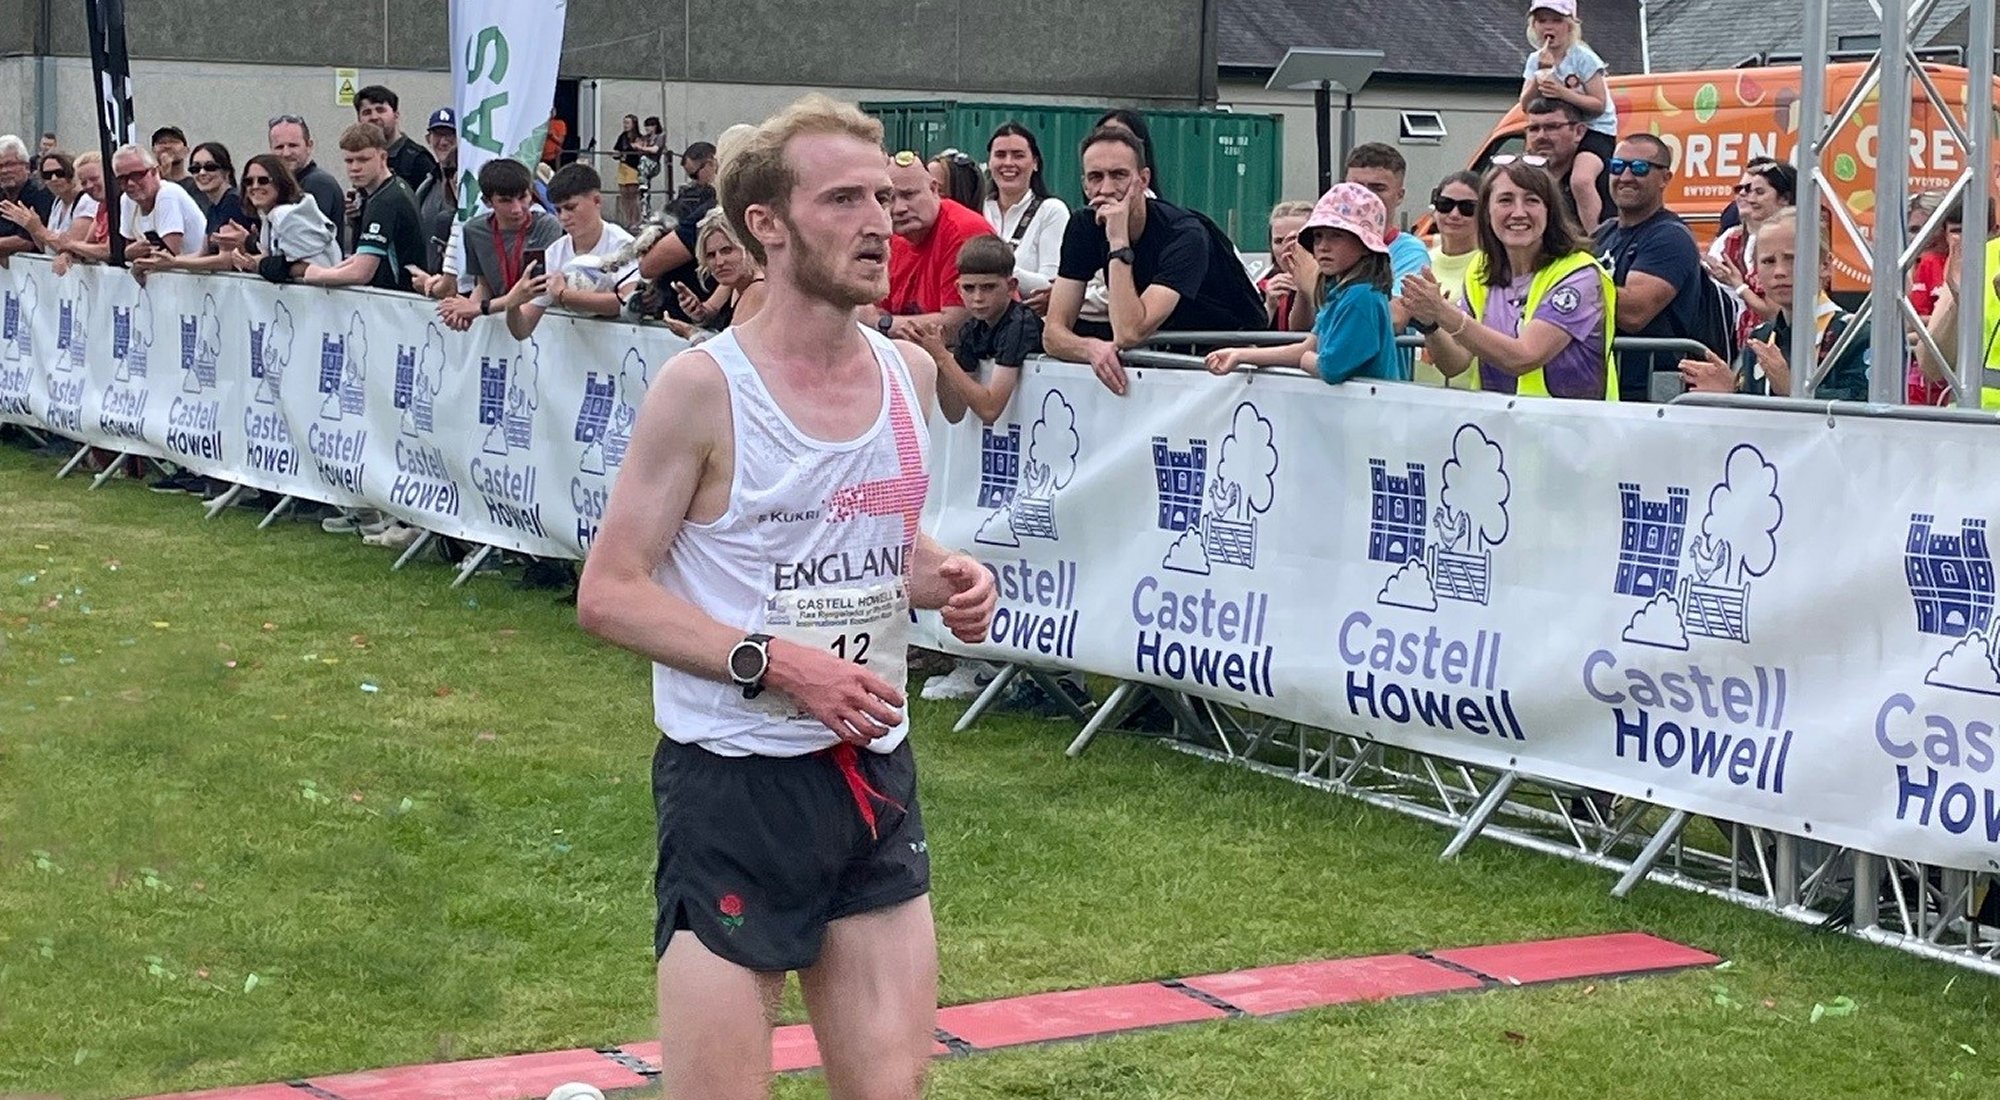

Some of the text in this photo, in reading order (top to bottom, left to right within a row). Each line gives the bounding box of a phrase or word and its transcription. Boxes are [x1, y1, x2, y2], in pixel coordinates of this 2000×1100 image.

[0, 366, 34, 393] astell
[101, 384, 149, 418] Castell
[169, 396, 219, 431] Castell
[166, 427, 222, 461] Howell
[244, 406, 294, 443] Caste
[308, 422, 368, 463] Castell
[246, 440, 300, 476] Howell
[314, 456, 366, 496] Howell
[395, 438, 451, 481] Castell
[390, 475, 460, 516] Howell
[470, 457, 537, 504] Castell
[571, 476, 608, 520] Cast
[482, 494, 550, 538] Howell
[770, 509, 820, 523] KUKRI
[797, 598, 855, 610] CASTELL
[979, 557, 1077, 610] astell
[1132, 576, 1268, 647] Castell
[831, 632, 870, 665] 12
[990, 607, 1079, 659] owell
[1338, 610, 1501, 690] Castell
[1136, 631, 1275, 698] Howell
[1346, 670, 1526, 741] Howell
[1583, 649, 1787, 731] Castell
[1612, 707, 1794, 794] Howell
